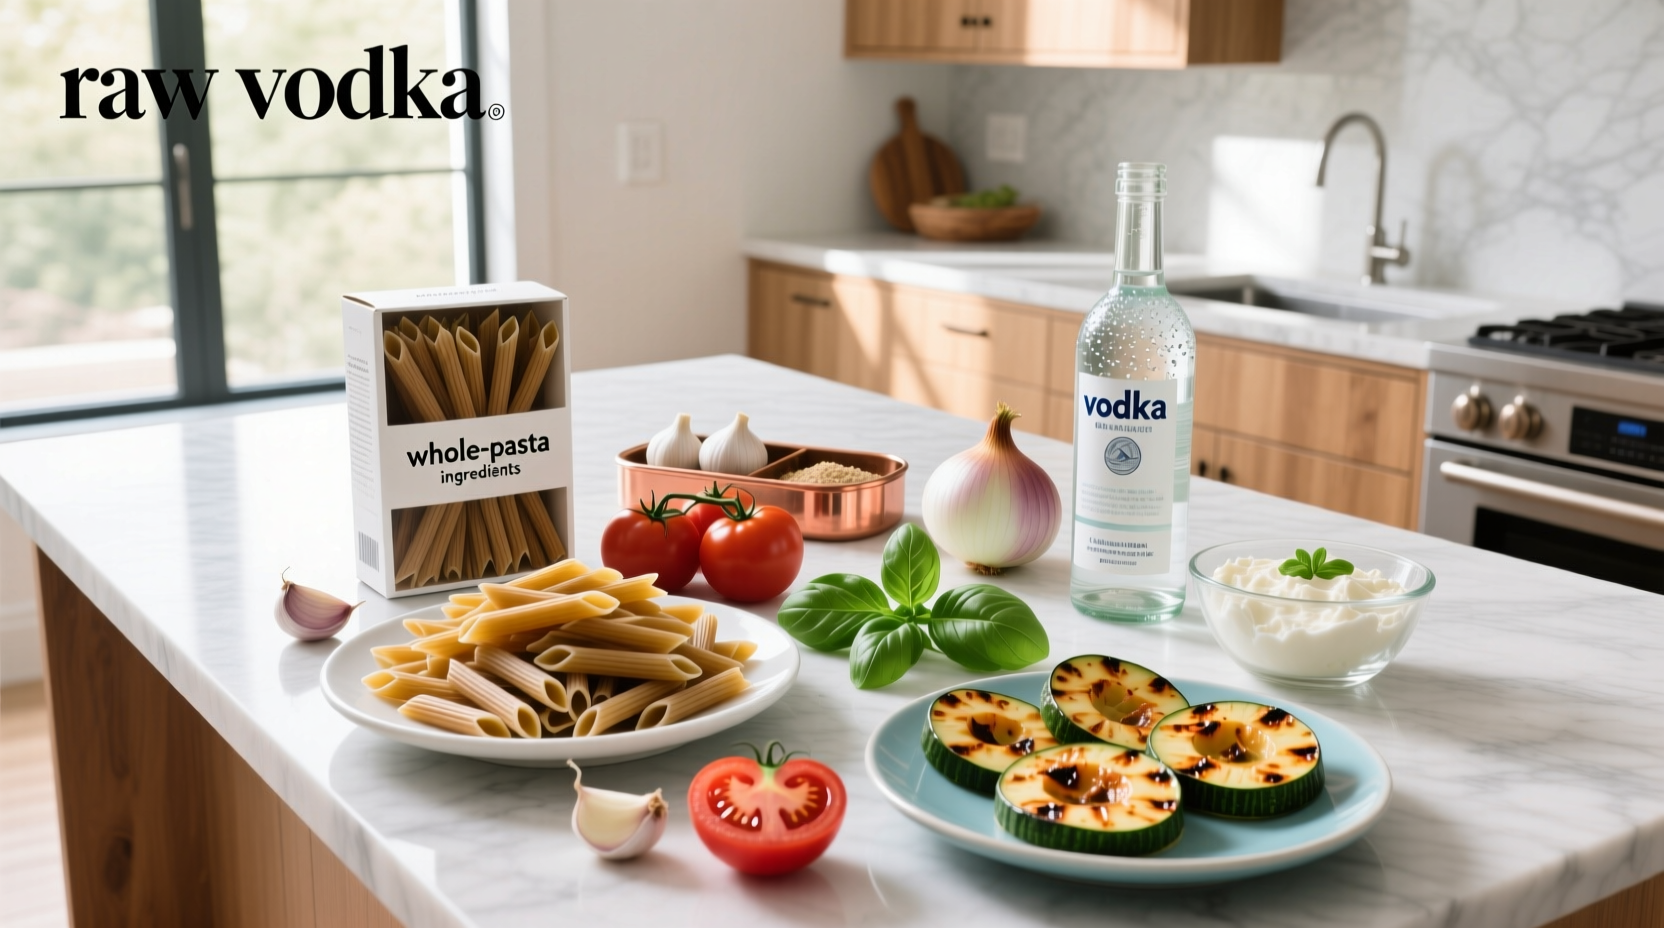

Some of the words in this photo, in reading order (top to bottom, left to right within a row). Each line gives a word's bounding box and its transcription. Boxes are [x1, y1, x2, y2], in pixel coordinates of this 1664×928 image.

[1083, 389, 1167, 420] vodka
[407, 433, 550, 467] whole-pasta
[441, 463, 521, 486] ingredients
